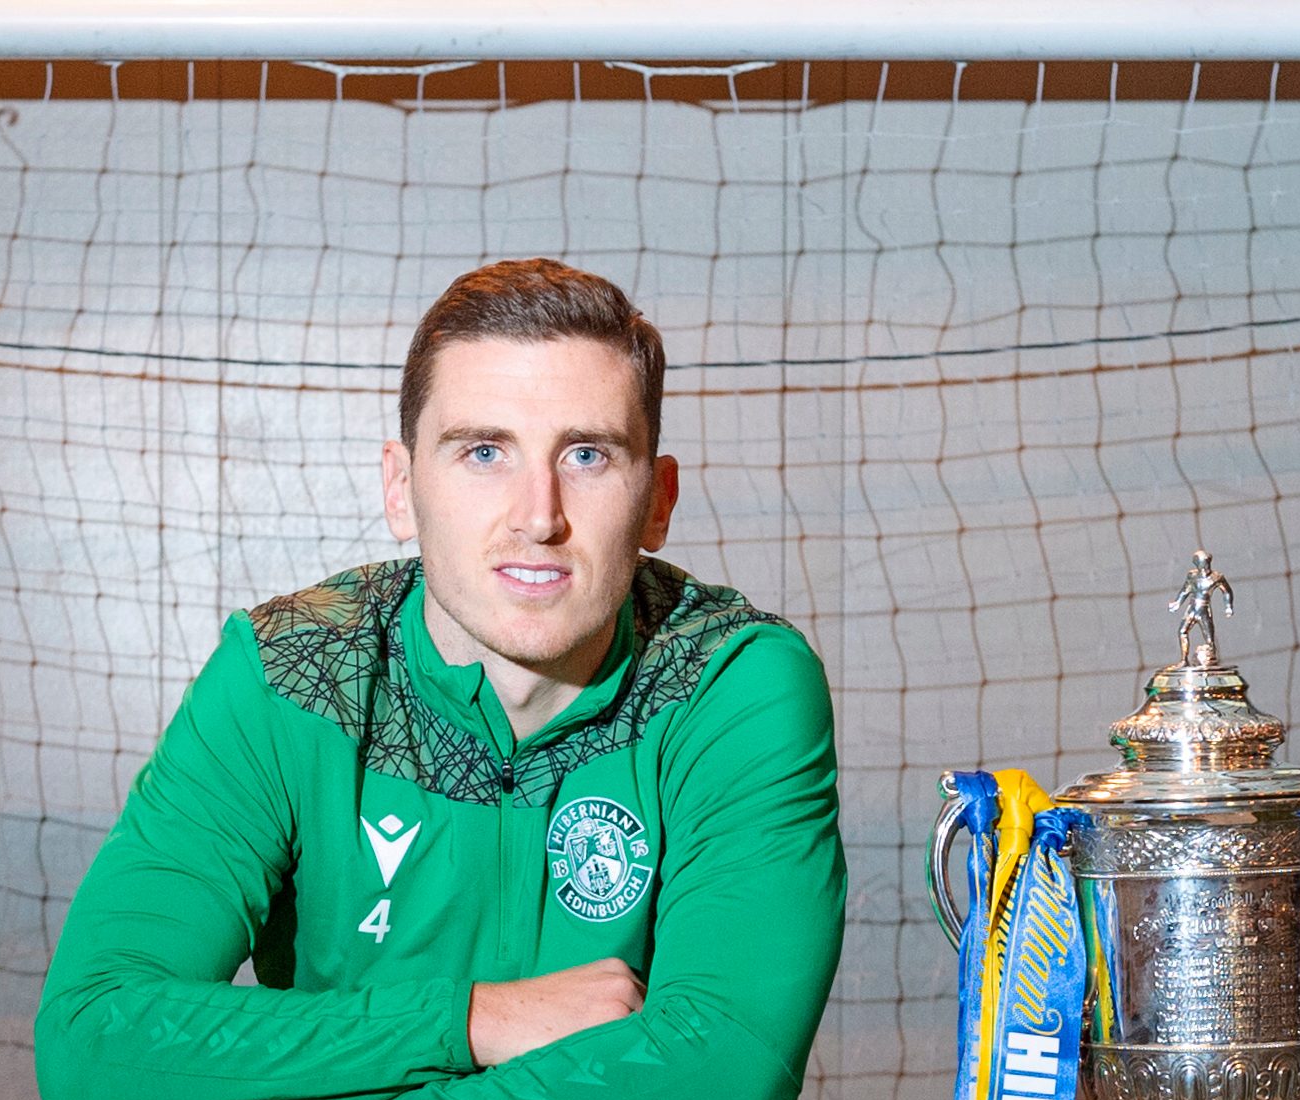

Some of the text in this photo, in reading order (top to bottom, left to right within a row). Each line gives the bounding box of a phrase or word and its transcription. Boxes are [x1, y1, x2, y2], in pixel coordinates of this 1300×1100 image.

[551, 802, 634, 844] HIBERNIAN
[552, 859, 569, 878] 18
[565, 875, 643, 917] EDINBURGH
[358, 899, 391, 943] 4
